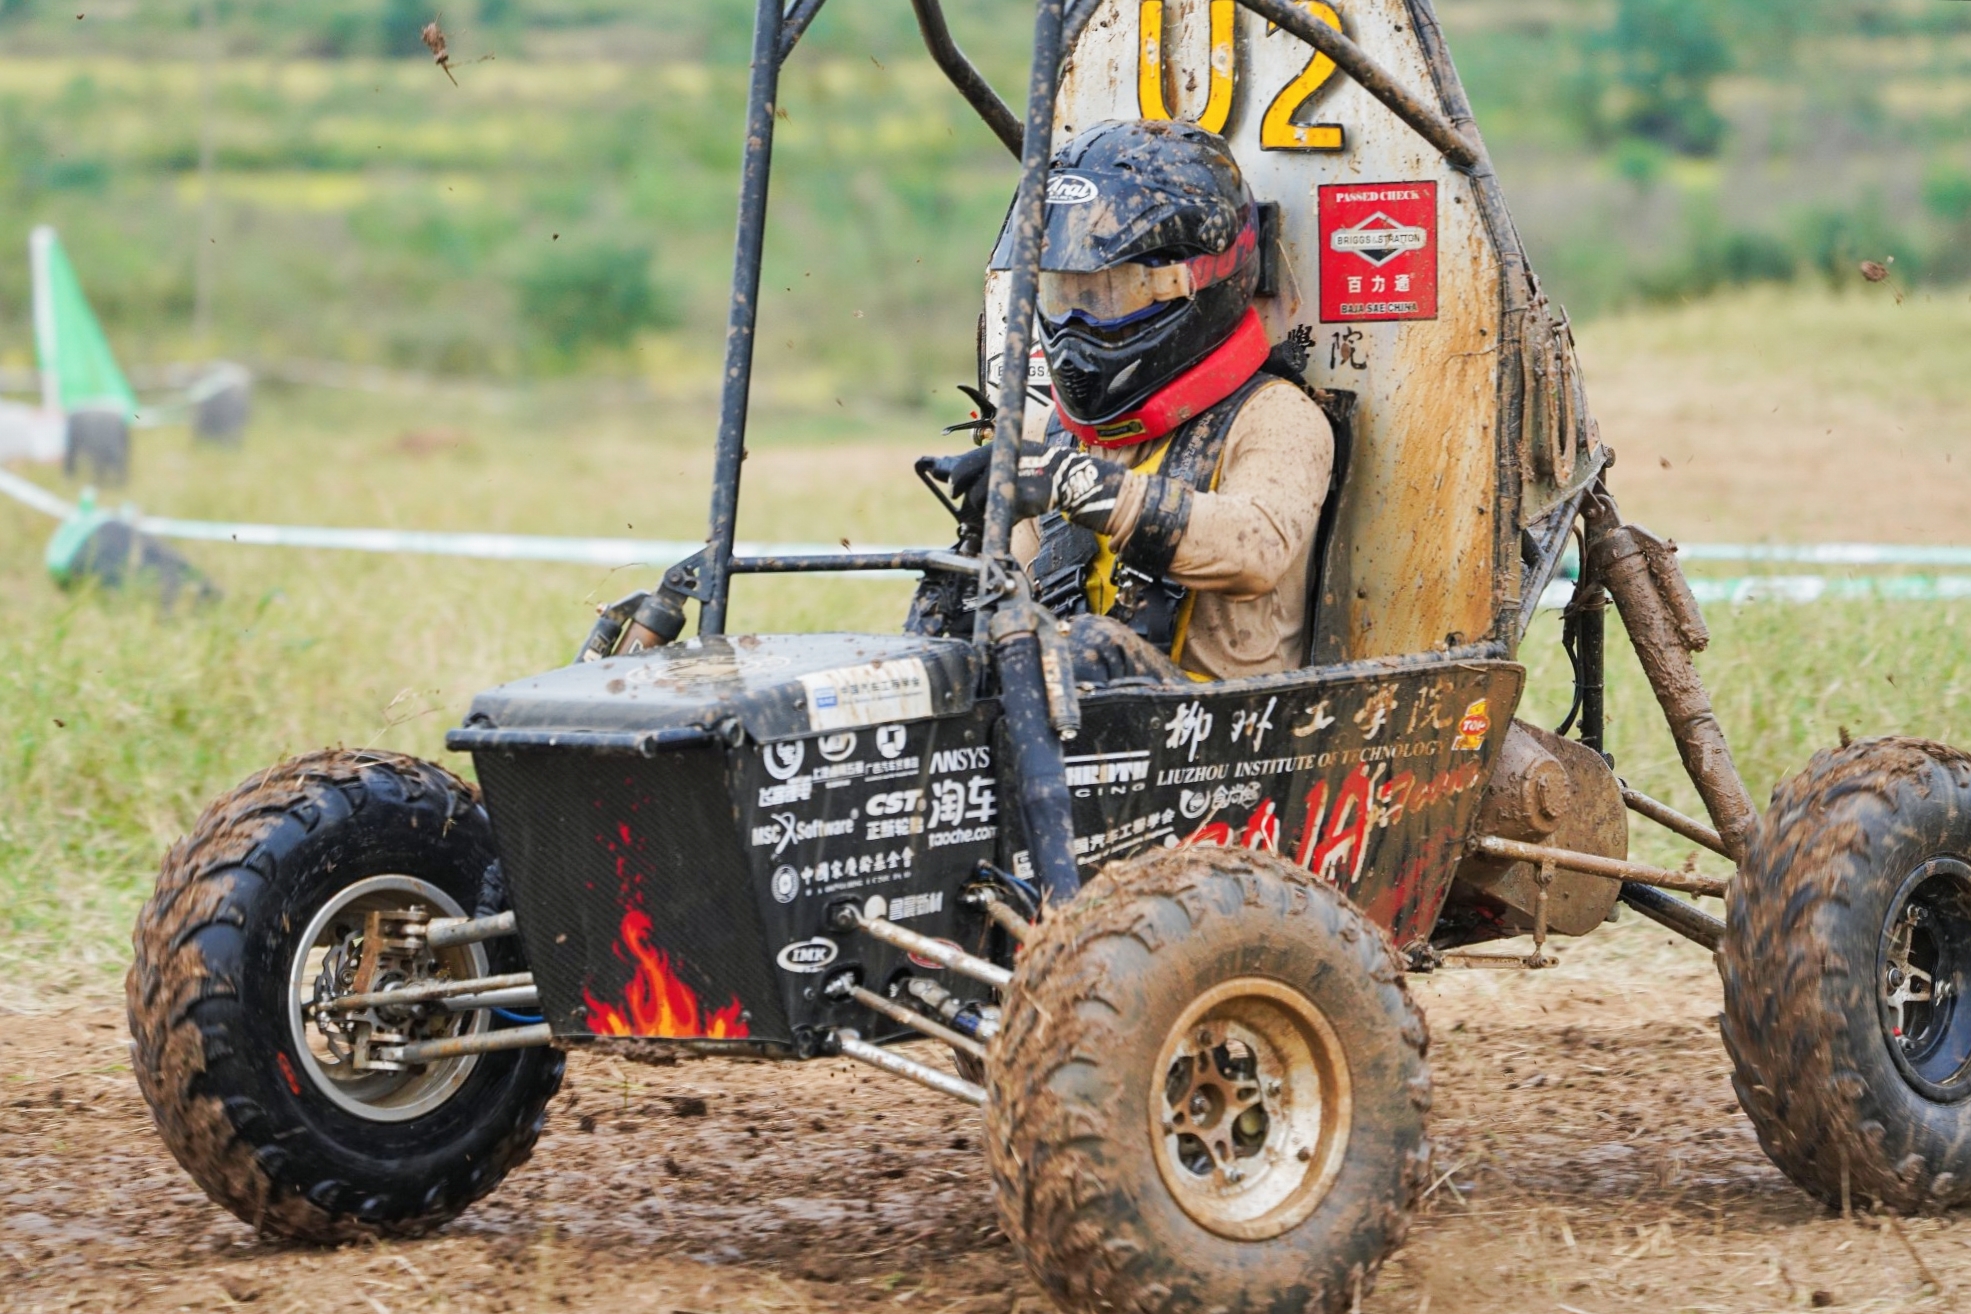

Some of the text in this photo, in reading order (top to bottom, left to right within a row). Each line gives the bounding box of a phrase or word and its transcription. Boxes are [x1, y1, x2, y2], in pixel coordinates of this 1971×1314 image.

[1335, 190, 1420, 203] PASSED CHECK
[1346, 273, 1411, 294] 百力通
[1340, 301, 1418, 314] BAJA SAE CHINA
[1462, 720, 1487, 732] TOP
[929, 746, 990, 774] ANSYS
[1156, 763, 1230, 786] LIUZHOU
[1234, 753, 1316, 778] INSTITUTE
[865, 789, 924, 816] CST
[927, 775, 998, 829] 淘车
[1075, 783, 1146, 798] CING
[752, 825, 781, 846] MSC
[796, 818, 855, 841] Software
[1073, 808, 1176, 855] 国汽车工程学会
